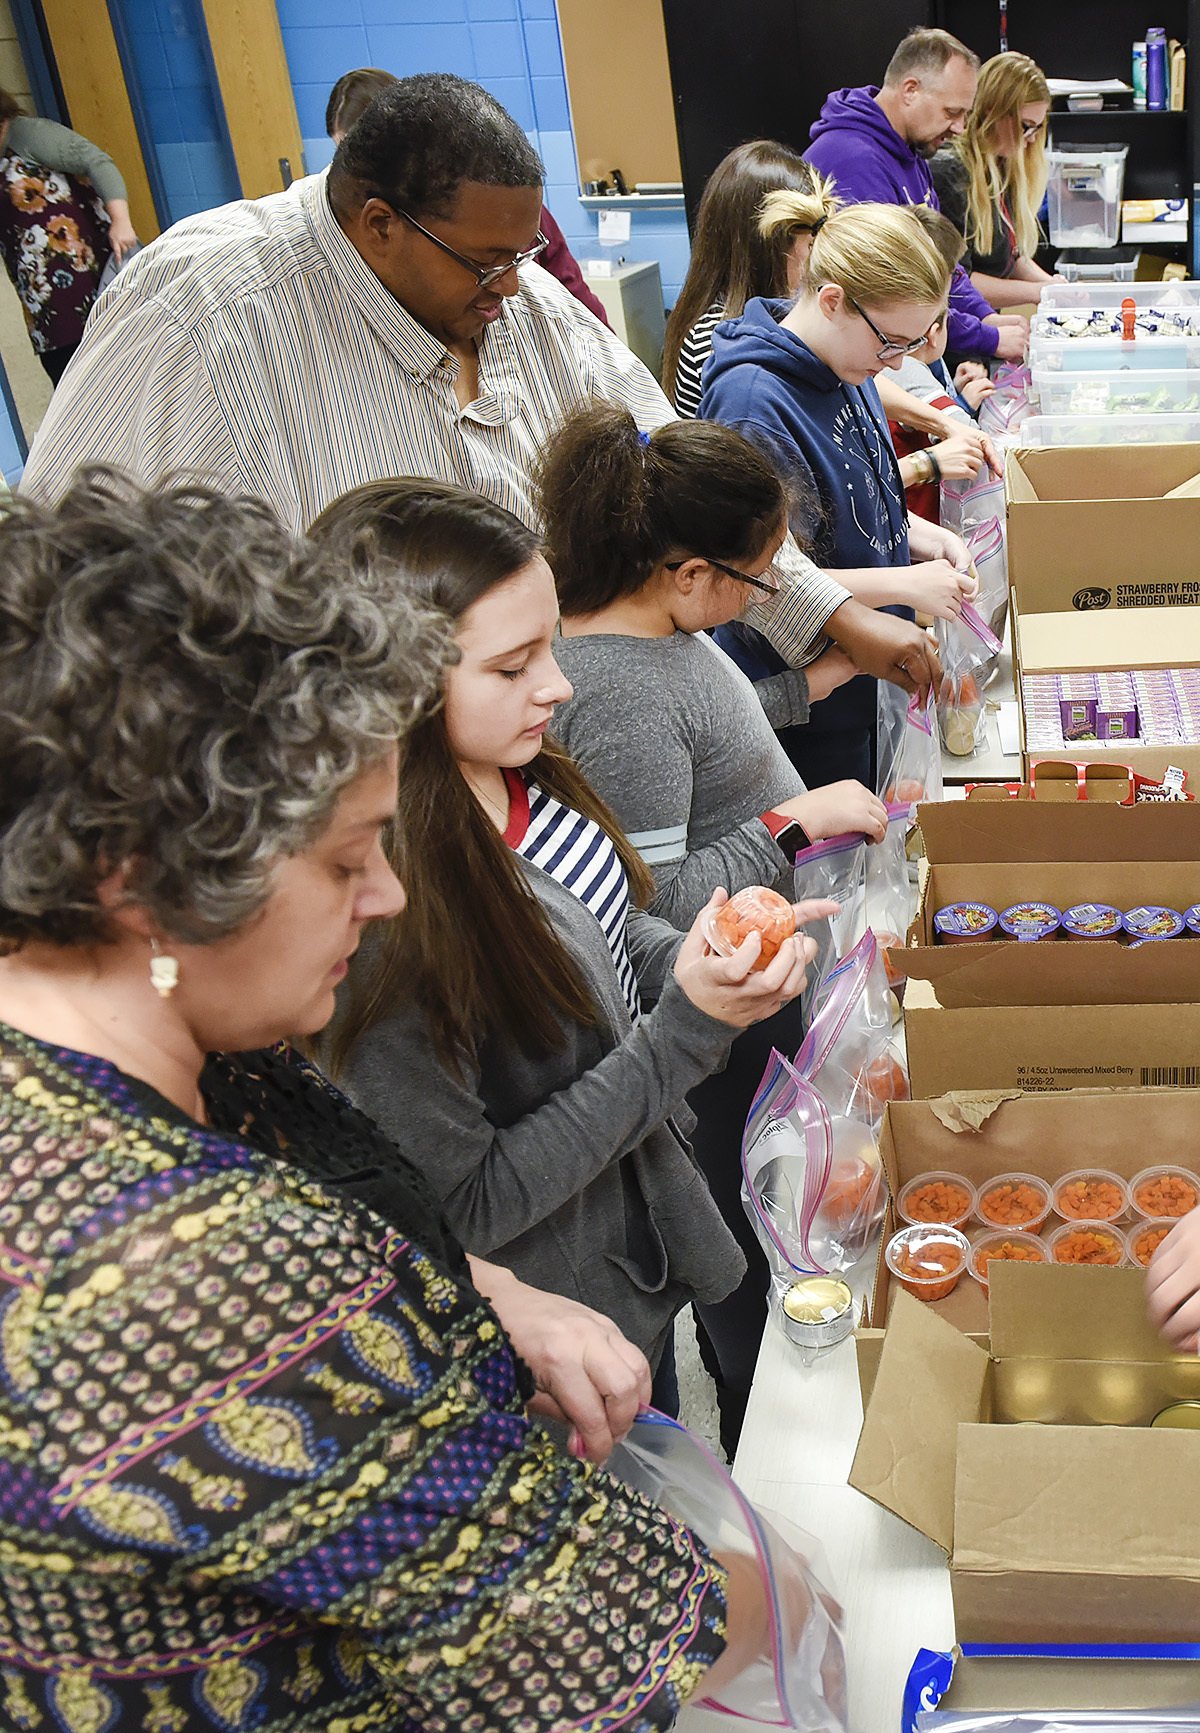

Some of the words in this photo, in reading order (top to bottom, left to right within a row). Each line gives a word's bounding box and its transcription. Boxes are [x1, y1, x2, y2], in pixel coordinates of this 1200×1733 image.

[832, 403, 873, 448] MINNEOT
[1116, 582, 1180, 596] STRAWBERRY
[1078, 591, 1106, 609] Post
[1116, 594, 1166, 607] SHREDDED
[1168, 593, 1200, 605] WHEAT
[1016, 1066, 1026, 1075] 96
[1049, 1066, 1094, 1075] Unsweetened
[1094, 1066, 1116, 1074] Mixed
[1116, 1065, 1134, 1076] Berry
